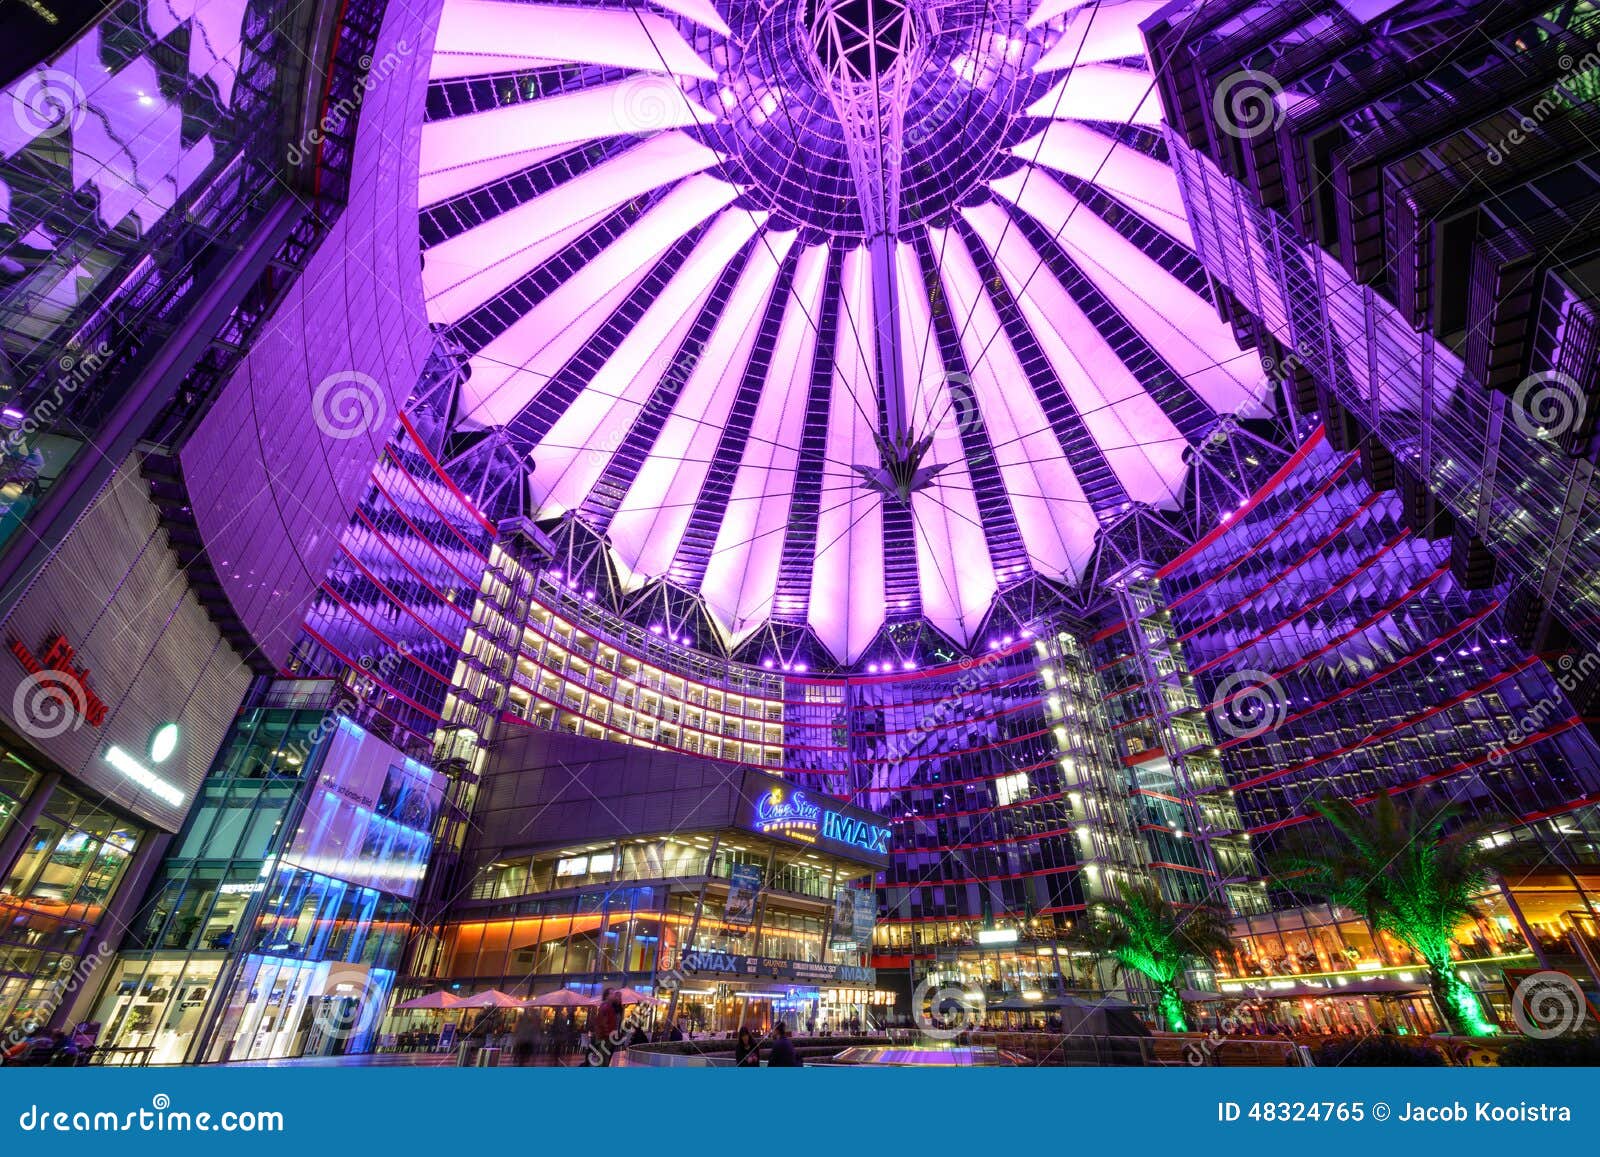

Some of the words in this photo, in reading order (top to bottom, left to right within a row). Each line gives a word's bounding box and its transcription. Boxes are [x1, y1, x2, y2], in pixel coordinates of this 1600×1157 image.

[823, 810, 888, 854] IMAX
[692, 952, 738, 973] IMAX
[841, 966, 872, 982] IMAX
